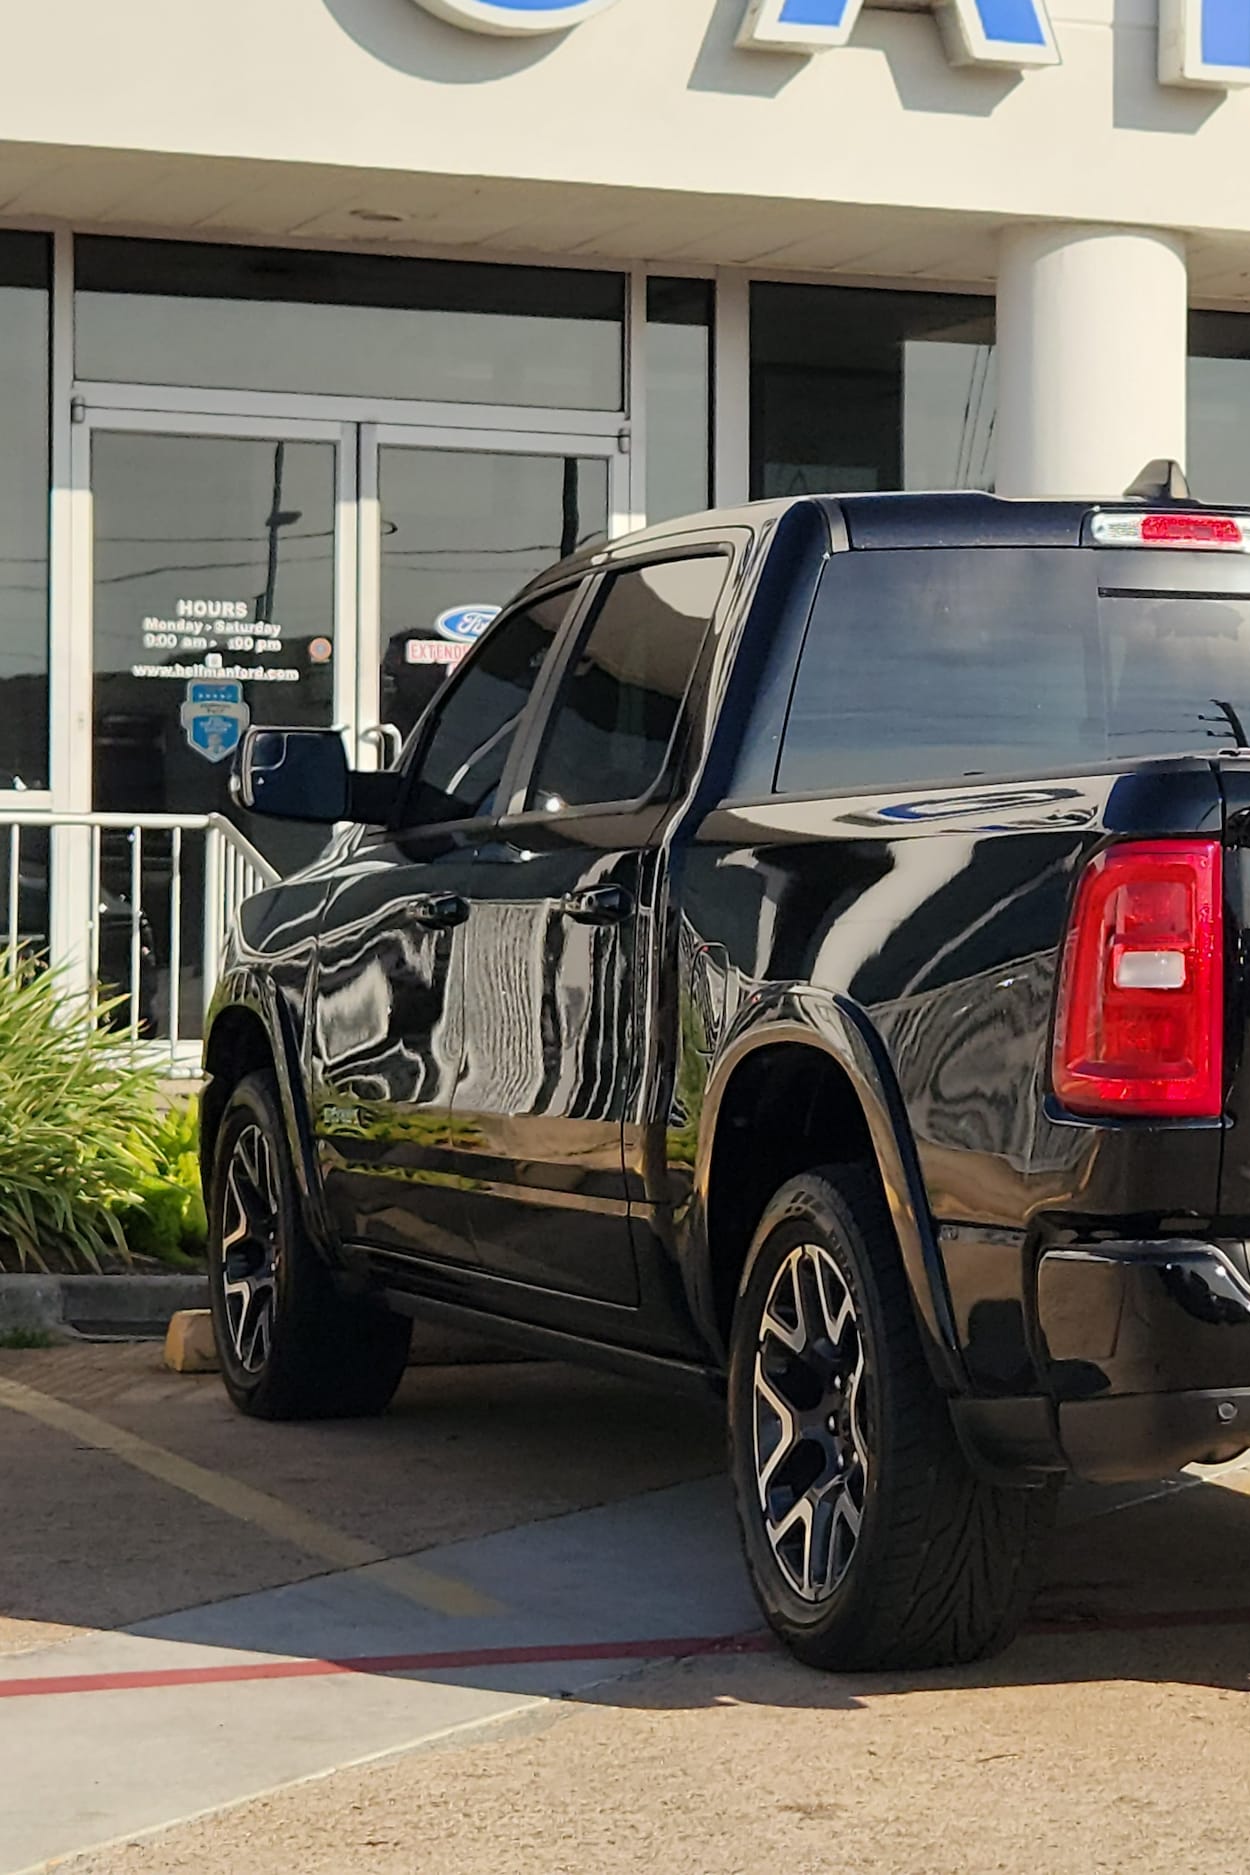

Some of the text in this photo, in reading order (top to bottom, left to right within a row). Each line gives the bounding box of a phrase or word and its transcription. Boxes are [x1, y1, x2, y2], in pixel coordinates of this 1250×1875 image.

[176, 599, 249, 618] HOURS
[142, 617, 204, 634] Monday
[214, 619, 282, 638] Saturday
[180, 637, 208, 650] am
[255, 641, 282, 654] pm
